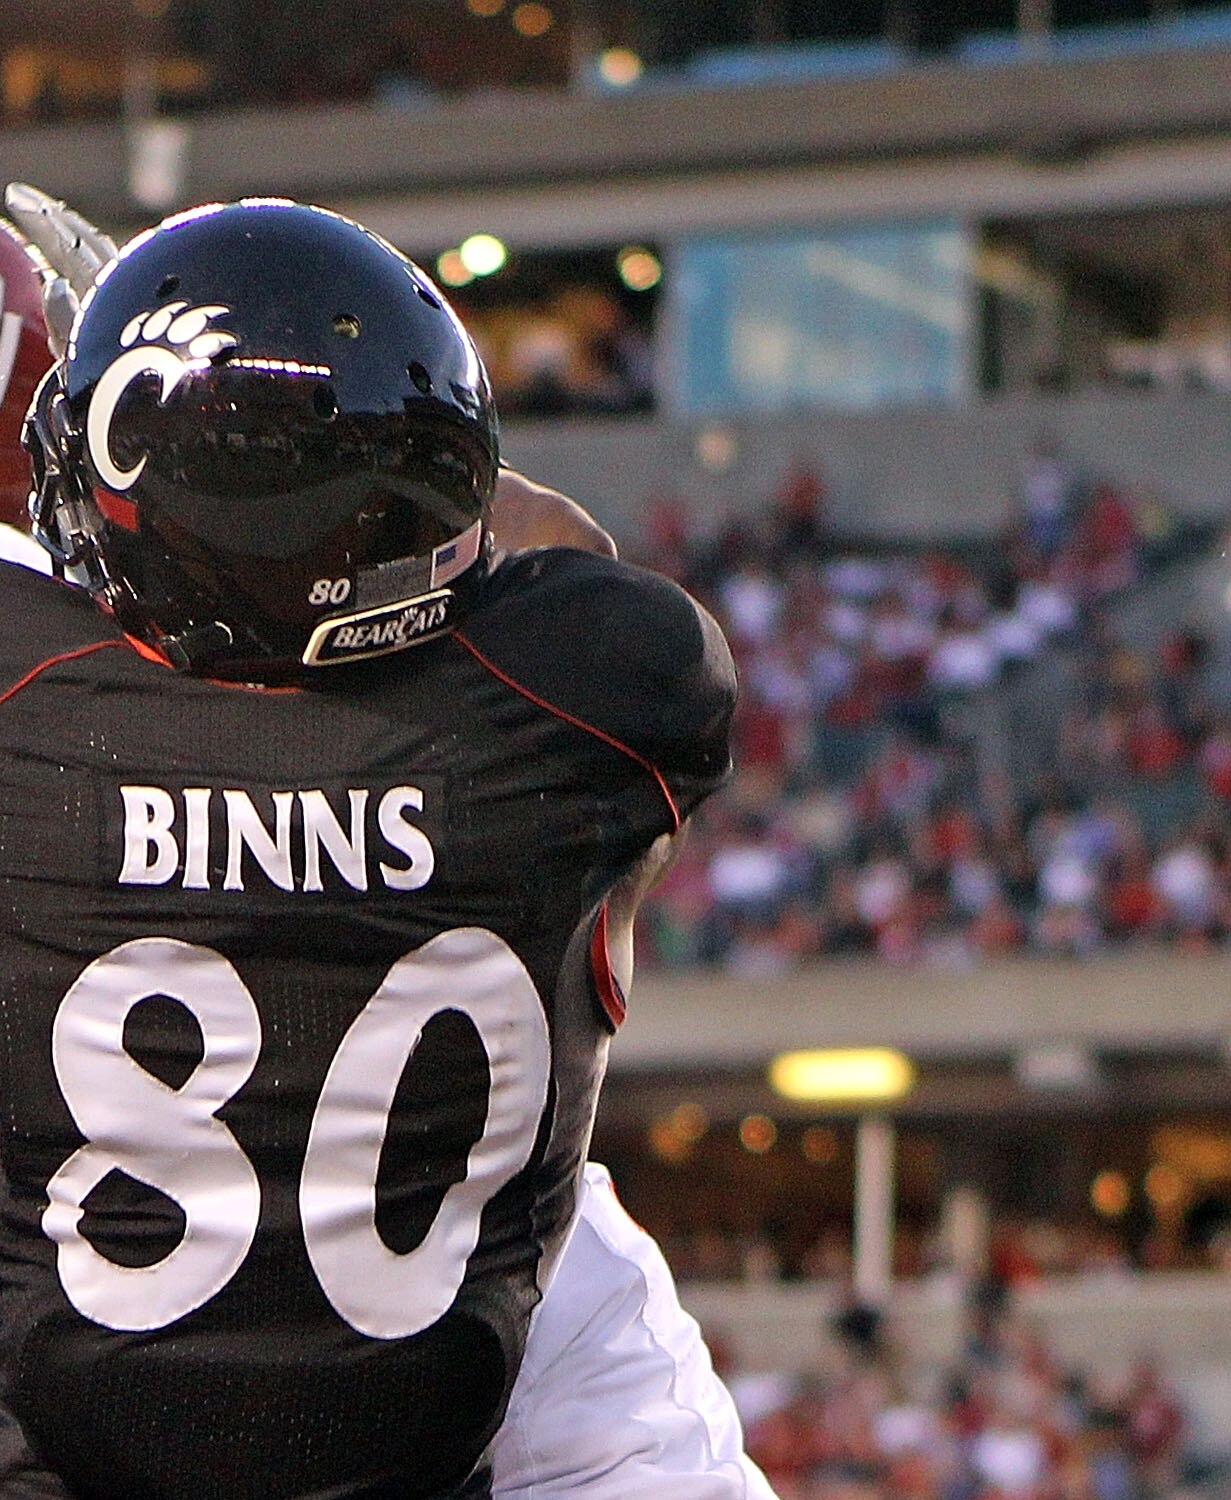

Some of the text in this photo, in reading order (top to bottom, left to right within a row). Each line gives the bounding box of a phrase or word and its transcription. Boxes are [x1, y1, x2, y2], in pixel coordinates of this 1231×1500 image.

[308, 577, 351, 605] 80
[332, 597, 450, 649] BEARCATS
[118, 785, 435, 892] BINNS
[41, 926, 551, 1340] 80
